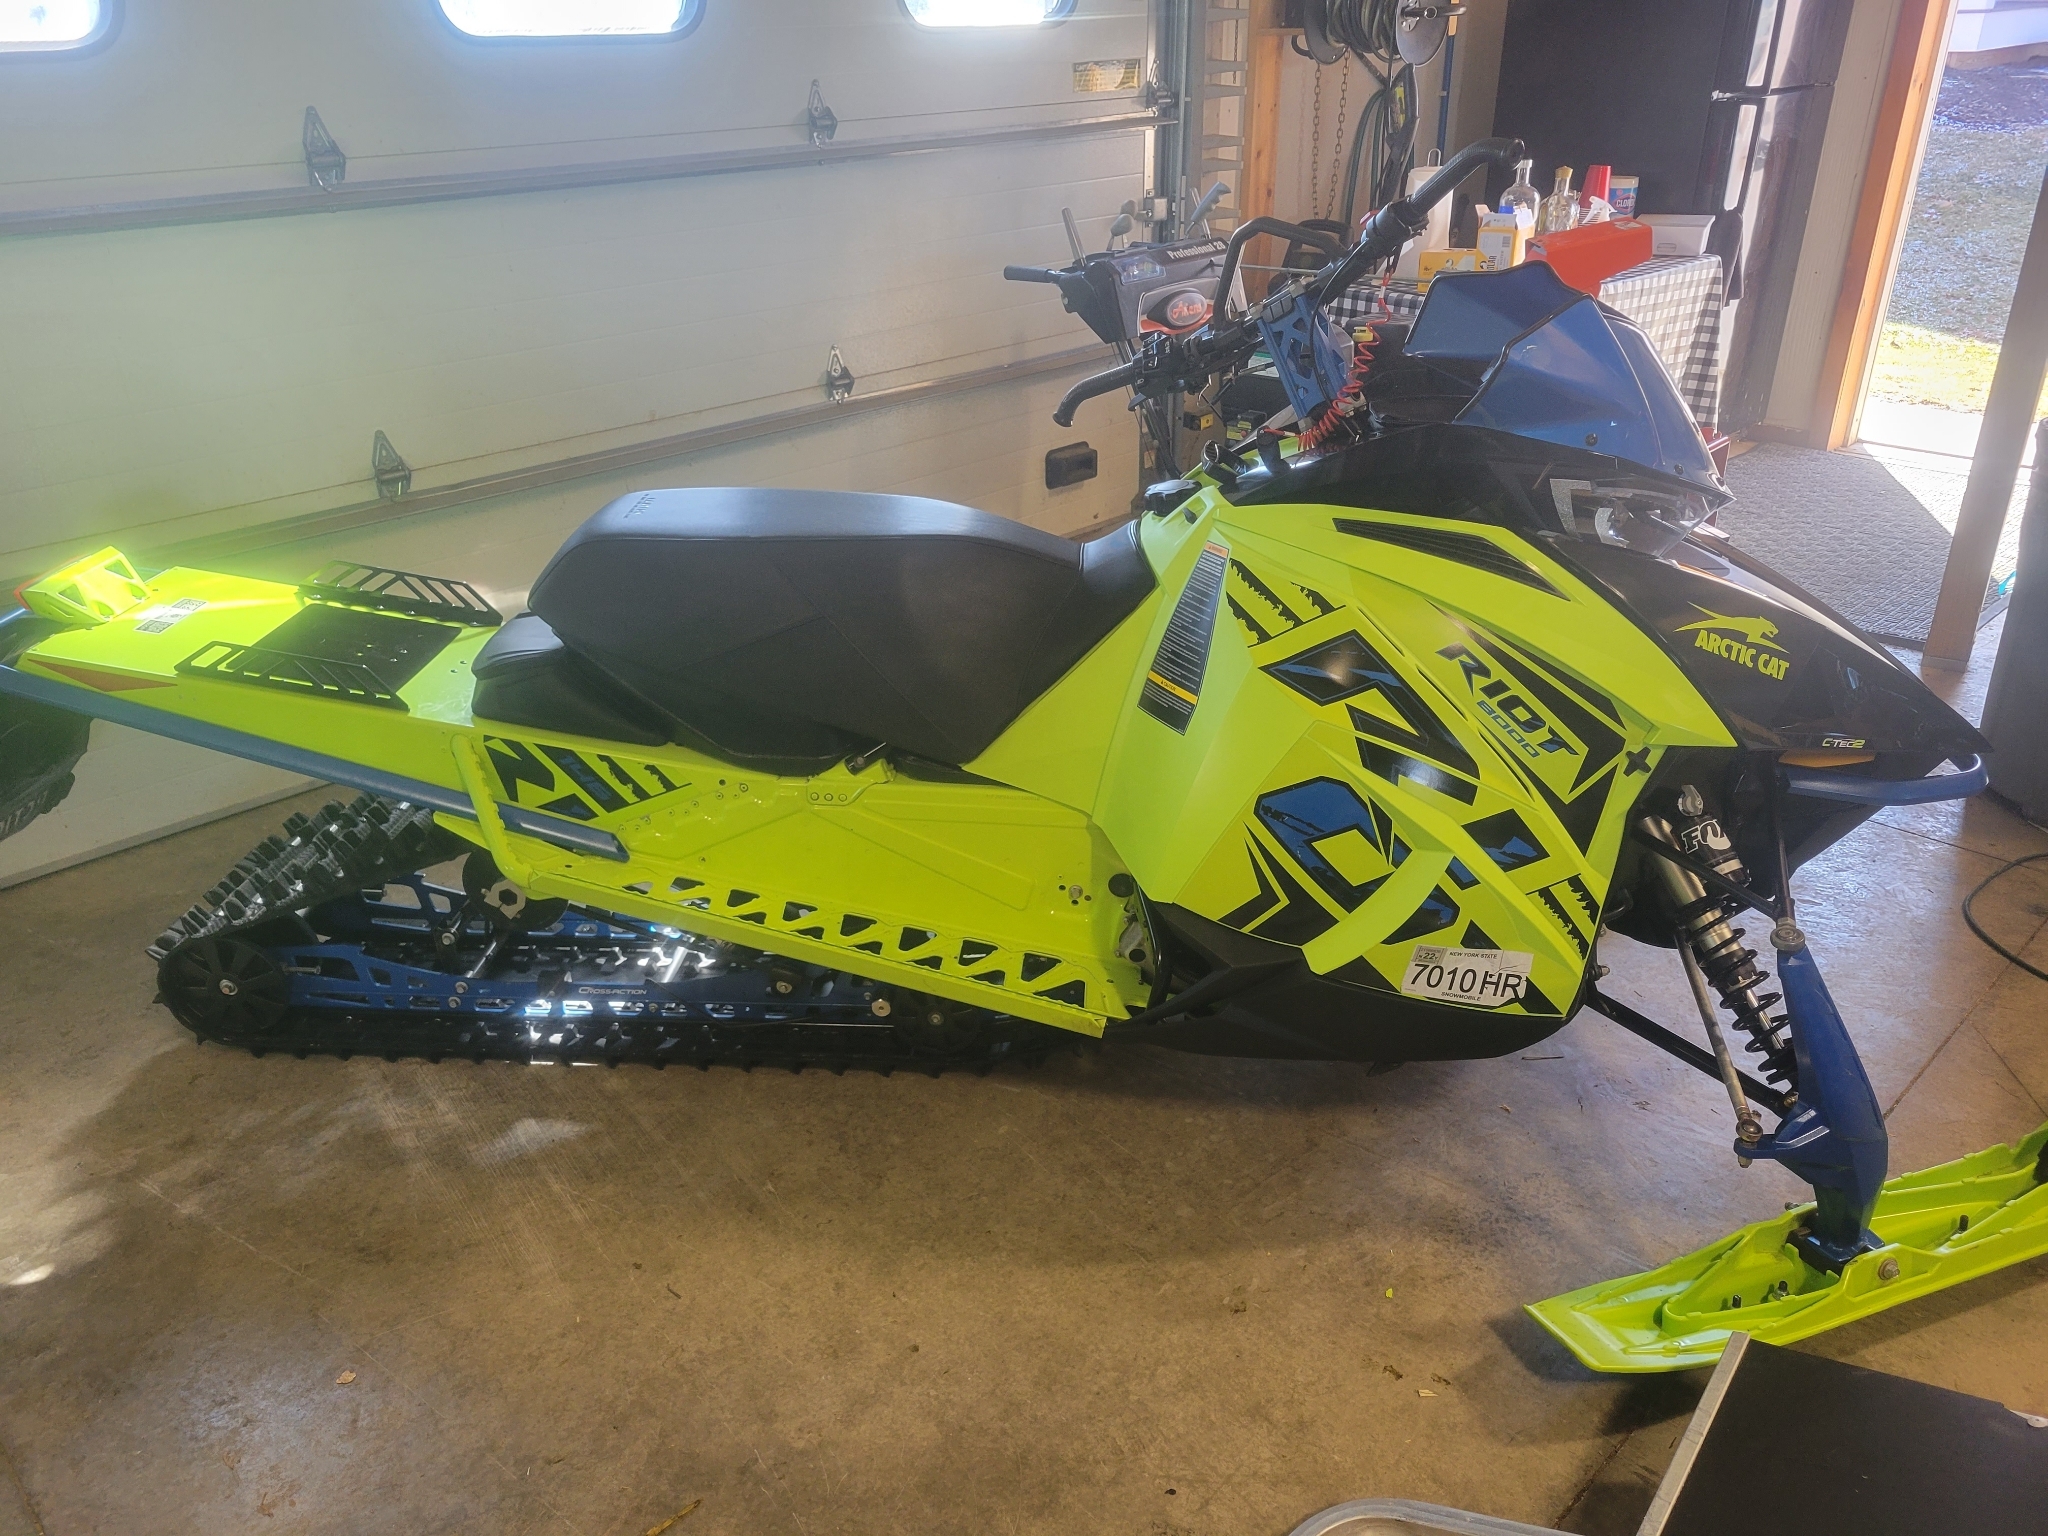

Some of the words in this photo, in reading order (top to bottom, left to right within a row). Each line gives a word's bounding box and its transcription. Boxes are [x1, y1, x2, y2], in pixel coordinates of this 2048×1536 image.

[1166, 242, 1216, 260] Professional
[1694, 629, 1757, 668] ARCTIC
[1757, 653, 1790, 681] CAT
[1435, 641, 1580, 756] RIOT
[1476, 700, 1540, 758] 8000
[1822, 738, 1866, 749] C-TEC2
[1424, 952, 1435, 960] 22
[1440, 991, 1482, 1001] SNOWMOBILE
